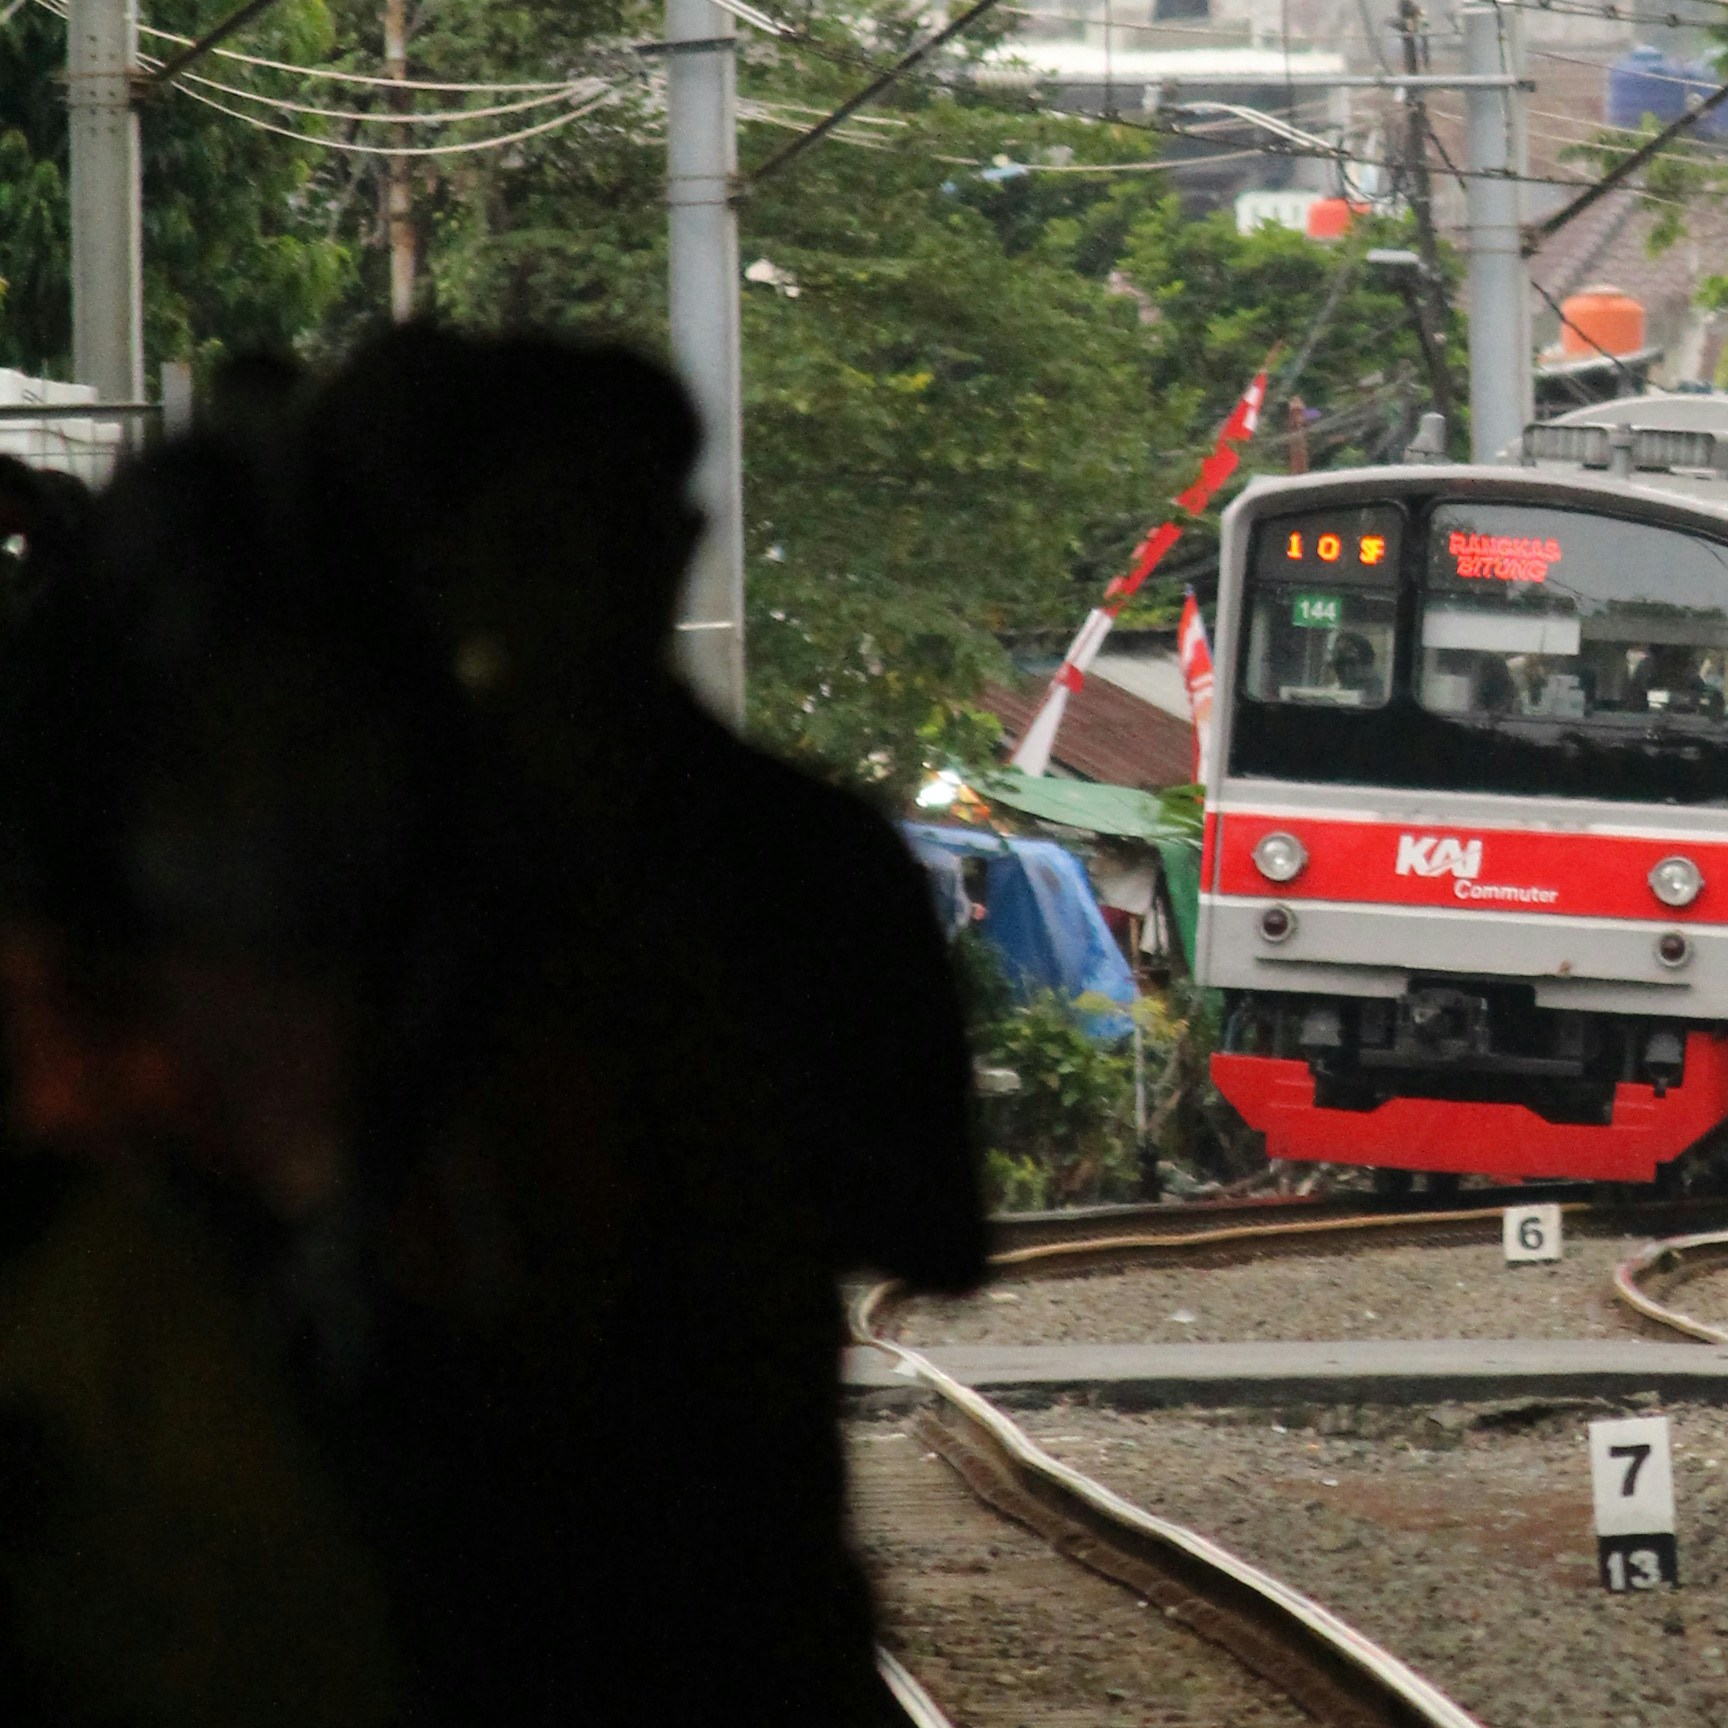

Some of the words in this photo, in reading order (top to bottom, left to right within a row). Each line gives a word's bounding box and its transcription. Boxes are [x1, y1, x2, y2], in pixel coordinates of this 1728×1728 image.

[1448, 530, 1562, 563] RANGKAS
[1456, 555, 1549, 584] BITUNG
[1299, 599, 1337, 621] 144
[1394, 834, 1484, 880] KAI
[1453, 878, 1560, 904] Commuter
[1519, 1215, 1544, 1251] 6
[1608, 1443, 1653, 1498] 7
[1606, 1548, 1663, 1592] 13
